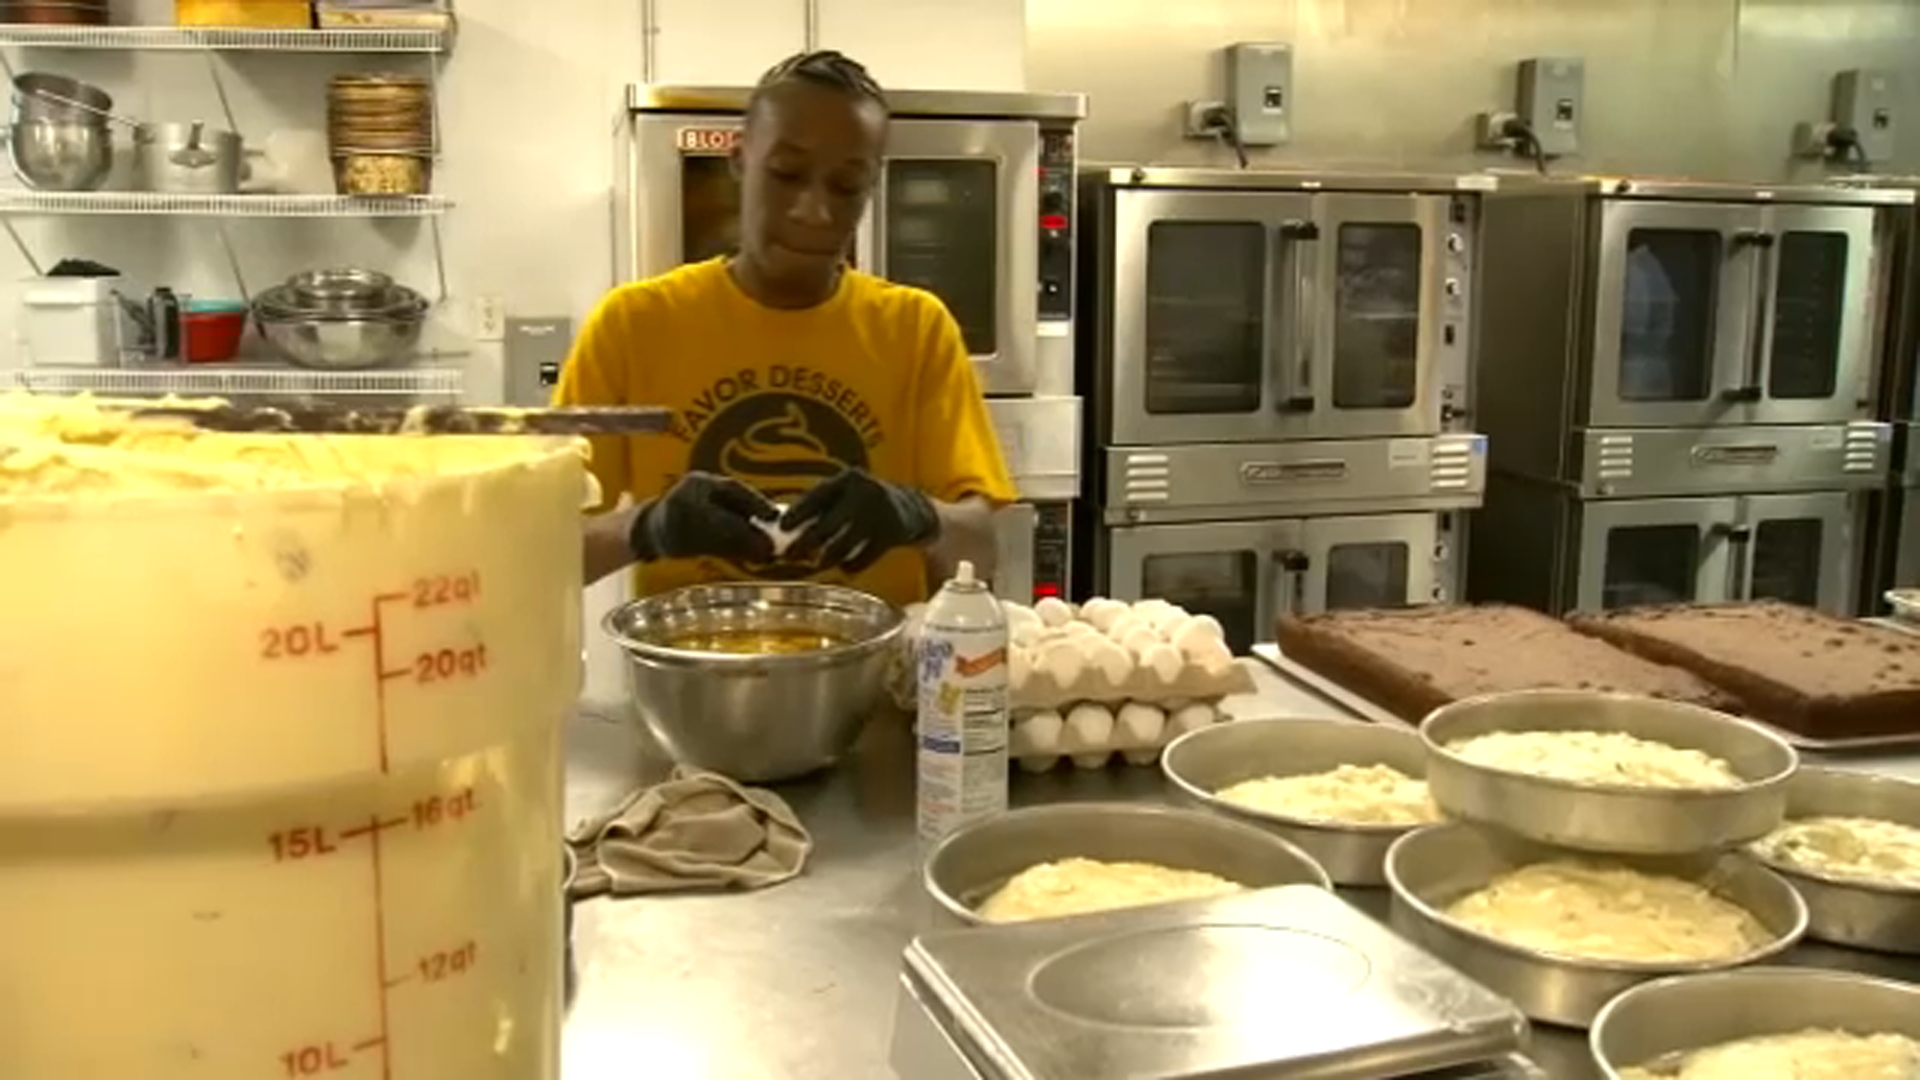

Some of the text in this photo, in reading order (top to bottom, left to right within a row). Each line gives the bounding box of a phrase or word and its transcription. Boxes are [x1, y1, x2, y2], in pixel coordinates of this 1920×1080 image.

[672, 364, 885, 449] FAVOR DESSERTS
[259, 624, 338, 659] 20L
[415, 641, 487, 684] 20qt
[410, 787, 476, 830] 16qt
[267, 827, 337, 862] 15L
[417, 940, 477, 983] 12qt
[279, 1041, 349, 1079] 10L
